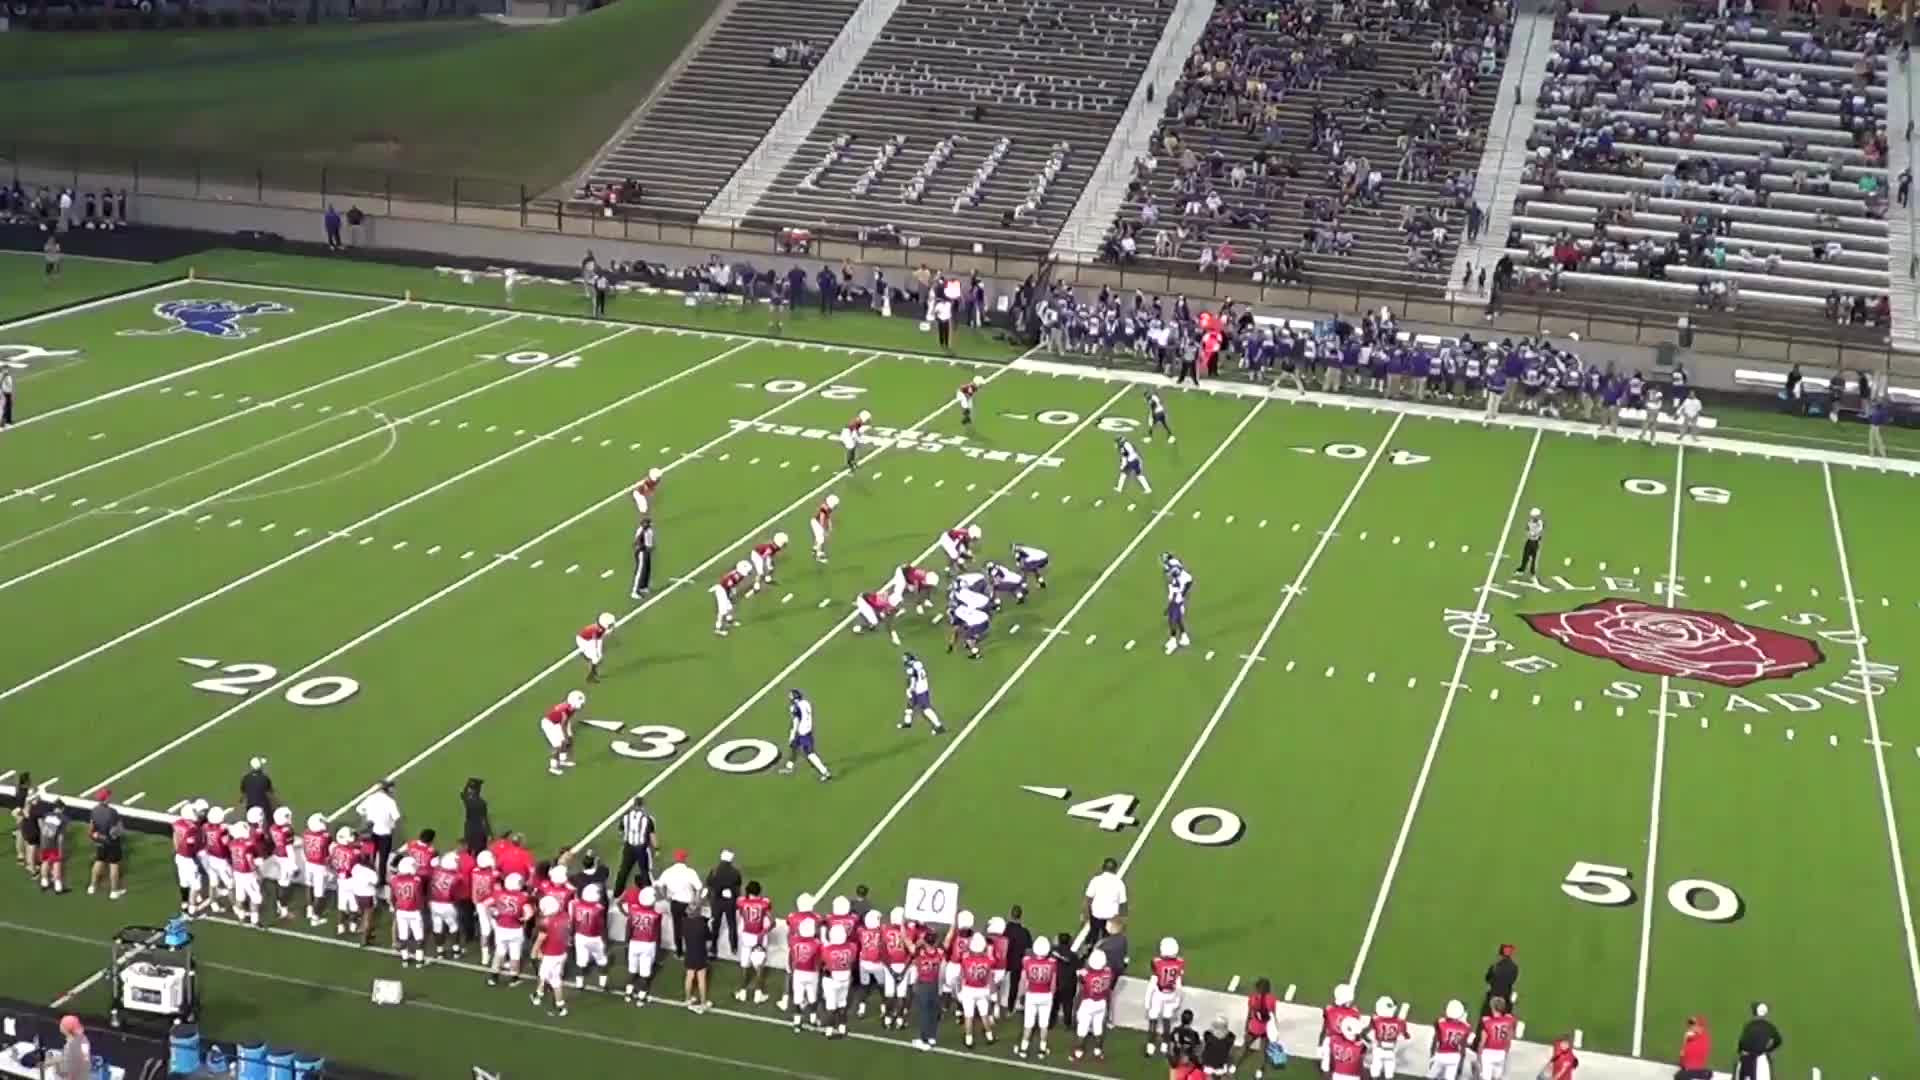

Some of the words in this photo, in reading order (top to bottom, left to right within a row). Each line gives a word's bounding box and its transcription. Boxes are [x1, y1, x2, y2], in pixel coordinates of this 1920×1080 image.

[764, 380, 868, 400] 20
[728, 418, 944, 453] CAMBELL
[1037, 410, 1140, 433] 30
[1325, 444, 1431, 465] 40
[1624, 479, 1731, 504] 50
[1474, 575, 1689, 599] TYLER
[1743, 598, 1868, 645] ISD
[1443, 608, 1558, 673] ROSE
[1603, 659, 1900, 713] STADIUM
[191, 663, 360, 706] 20
[611, 725, 779, 773] 30
[1067, 793, 1243, 845] 40
[915, 886, 946, 914] 20
[1561, 861, 1740, 921] 50
